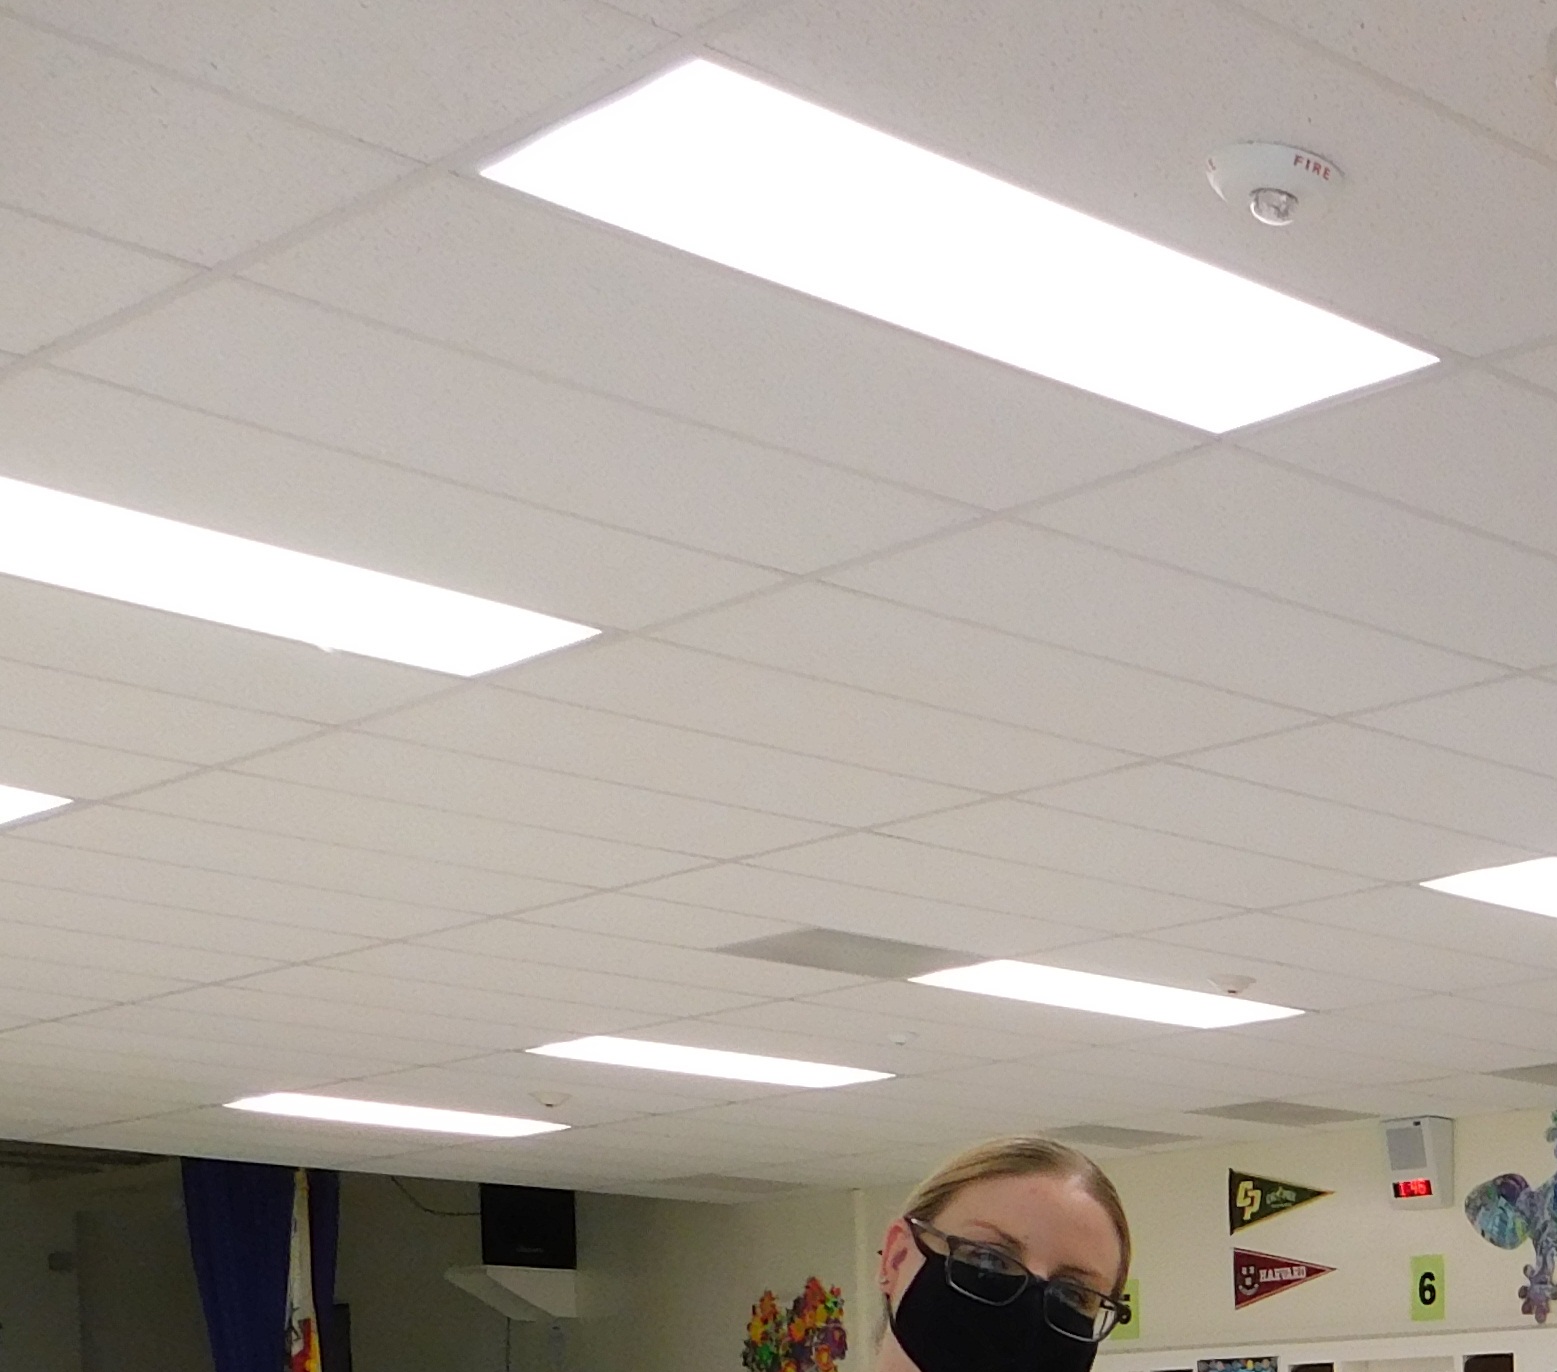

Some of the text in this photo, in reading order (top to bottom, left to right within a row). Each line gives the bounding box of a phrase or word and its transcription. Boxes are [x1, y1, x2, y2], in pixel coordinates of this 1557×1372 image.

[1293, 154, 1331, 181] FIRE
[1259, 1265, 1307, 1283] HARVARD
[1418, 1271, 1436, 1305] 6
